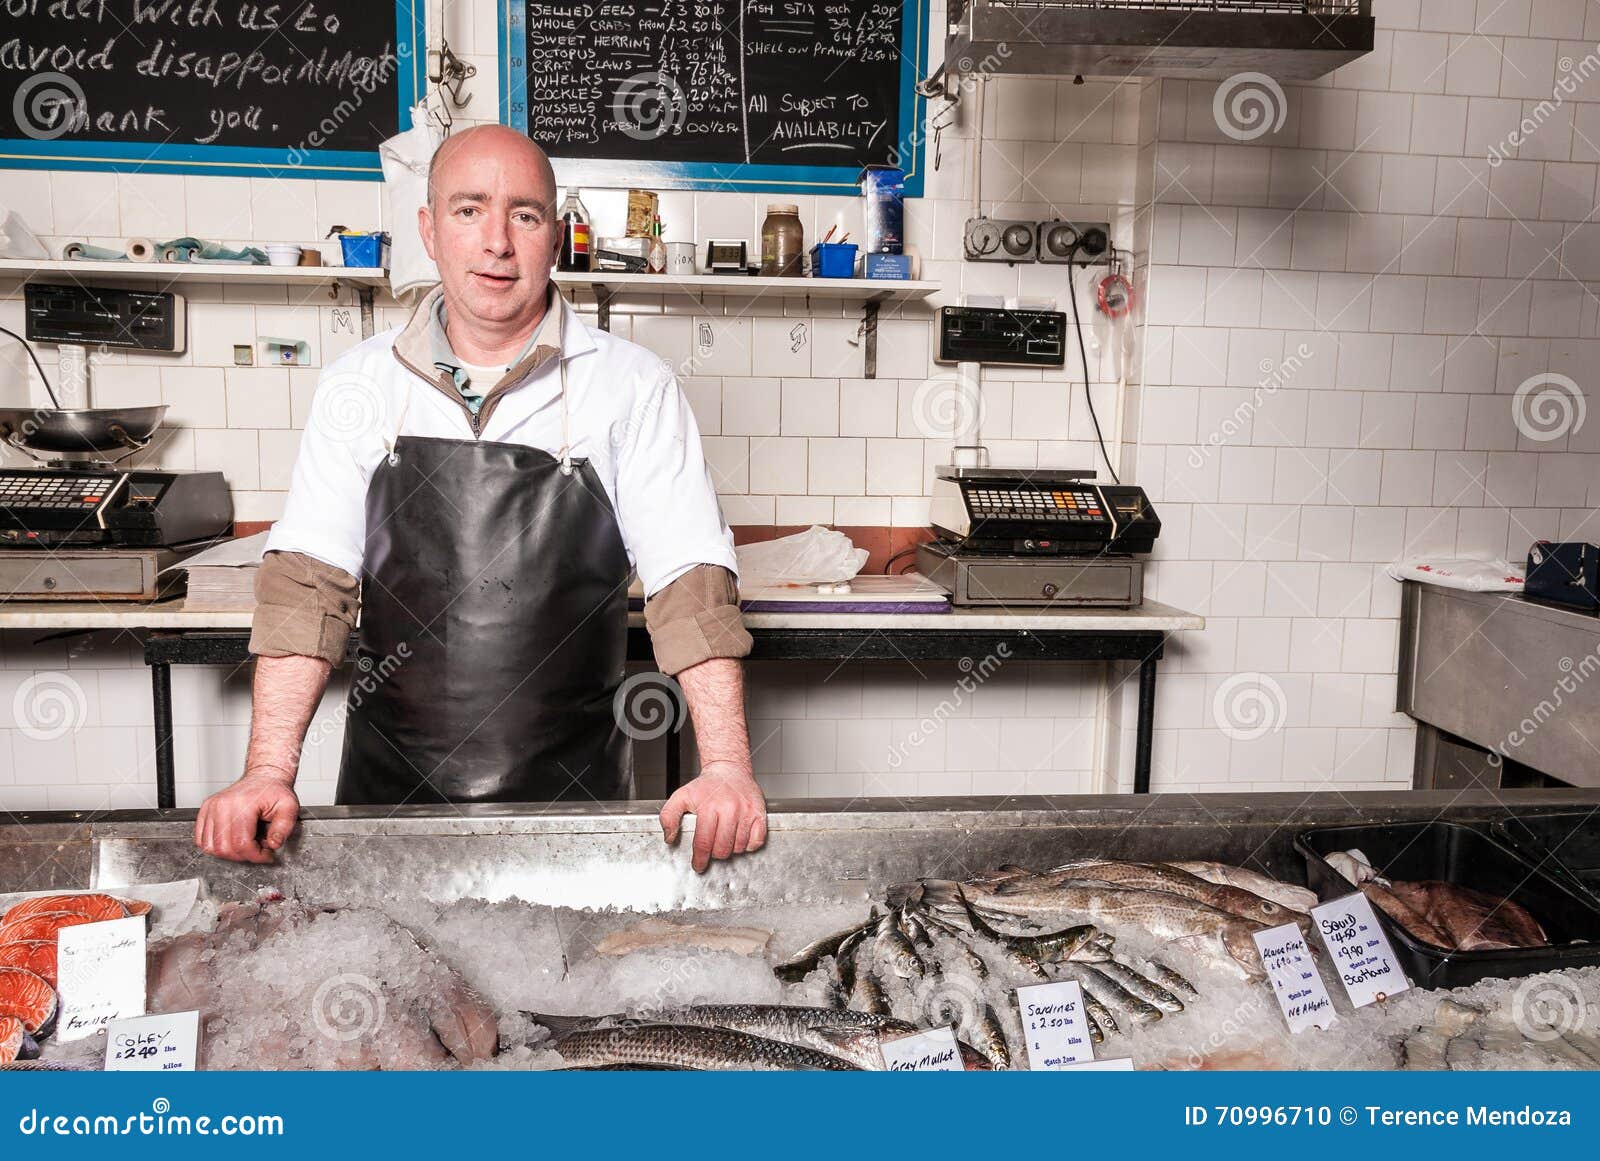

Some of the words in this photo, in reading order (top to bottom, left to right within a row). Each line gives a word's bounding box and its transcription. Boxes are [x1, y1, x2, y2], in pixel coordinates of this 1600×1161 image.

[600, 5, 635, 16] EELS
[784, 3, 815, 15] STIX
[824, 4, 850, 14] each
[238, 3, 280, 30] us
[294, 3, 340, 34] to
[532, 18, 575, 30] WHOLE
[594, 35, 651, 52] HERRING
[746, 42, 783, 56] SHELL
[0, 38, 114, 72] avoid
[532, 48, 596, 60] OCTOPUS
[585, 60, 632, 70] CLAWS
[534, 73, 603, 89] WHELKS
[533, 87, 603, 100] COCKLES
[531, 101, 596, 116] MUSSELS
[535, 115, 586, 128] PRAWN
[772, 119, 887, 150] AVAILABILITY
[1027, 1002, 1075, 1016] Sardines
